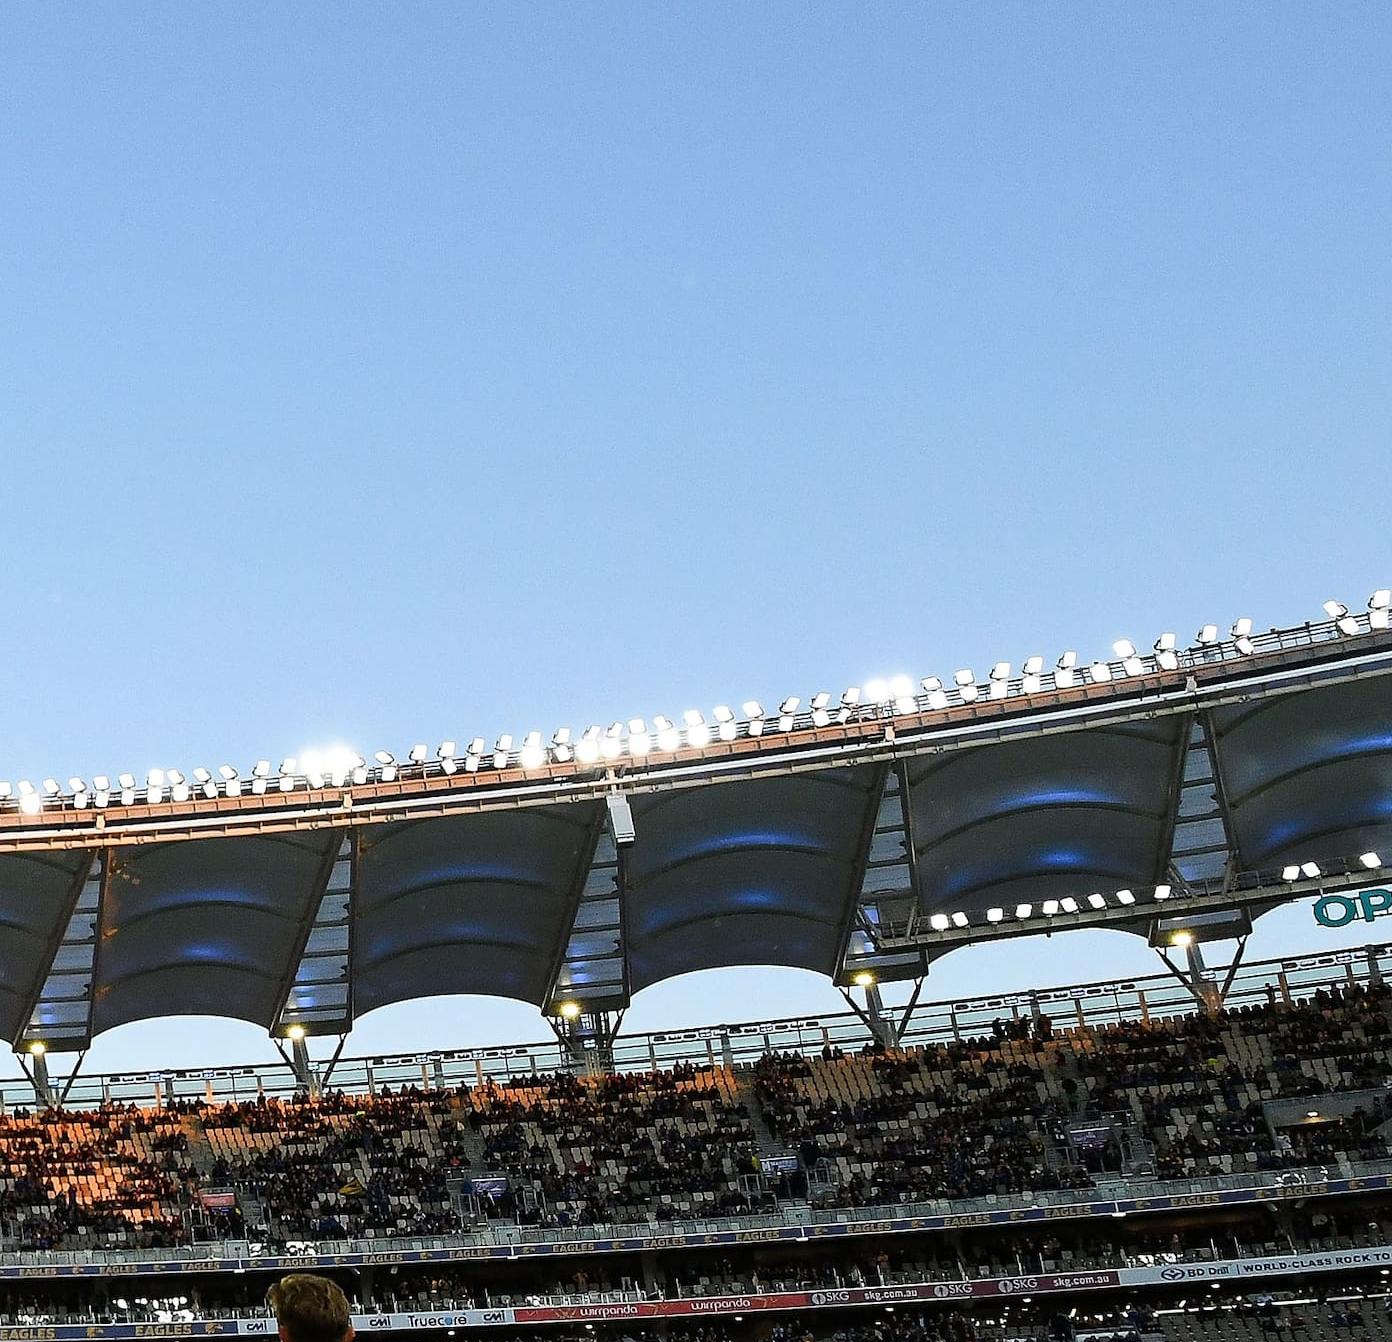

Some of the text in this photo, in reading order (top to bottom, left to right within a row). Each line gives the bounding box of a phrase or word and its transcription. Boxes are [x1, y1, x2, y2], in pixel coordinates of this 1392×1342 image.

[1277, 1184, 1328, 1198] EAGLES
[1170, 1194, 1220, 1207] EAGLES
[1044, 1206, 1092, 1218] EAGLES
[943, 1215, 991, 1227] EAGLES
[846, 1222, 892, 1233] EAGLES
[735, 1231, 780, 1242] EAGLES
[552, 1243, 595, 1253] EAGLES
[642, 1238, 687, 1248] EAGLES
[362, 1254, 404, 1264] EAGLES
[449, 1249, 491, 1259] EAGLES
[181, 1262, 220, 1272] EAGLES
[278, 1257, 319, 1267] EAGLES
[1187, 1269, 1205, 1278] BD
[1244, 1257, 1332, 1274] WORLD-CLASS
[1336, 1254, 1371, 1265] ROCK
[19, 1267, 57, 1277] EAGLES
[99, 1265, 137, 1275] EAGLES
[1013, 1274, 1110, 1290] SKG skg.com.au
[825, 1288, 918, 1302] SKG skg.com.au
[949, 1284, 973, 1295] SKG
[691, 1299, 751, 1312] wirrpanda
[580, 1305, 638, 1318] wirrpanda
[408, 1315, 467, 1327] Truecore
[0, 1328, 56, 1340] EAGLES
[135, 1325, 192, 1336] EAGLES
